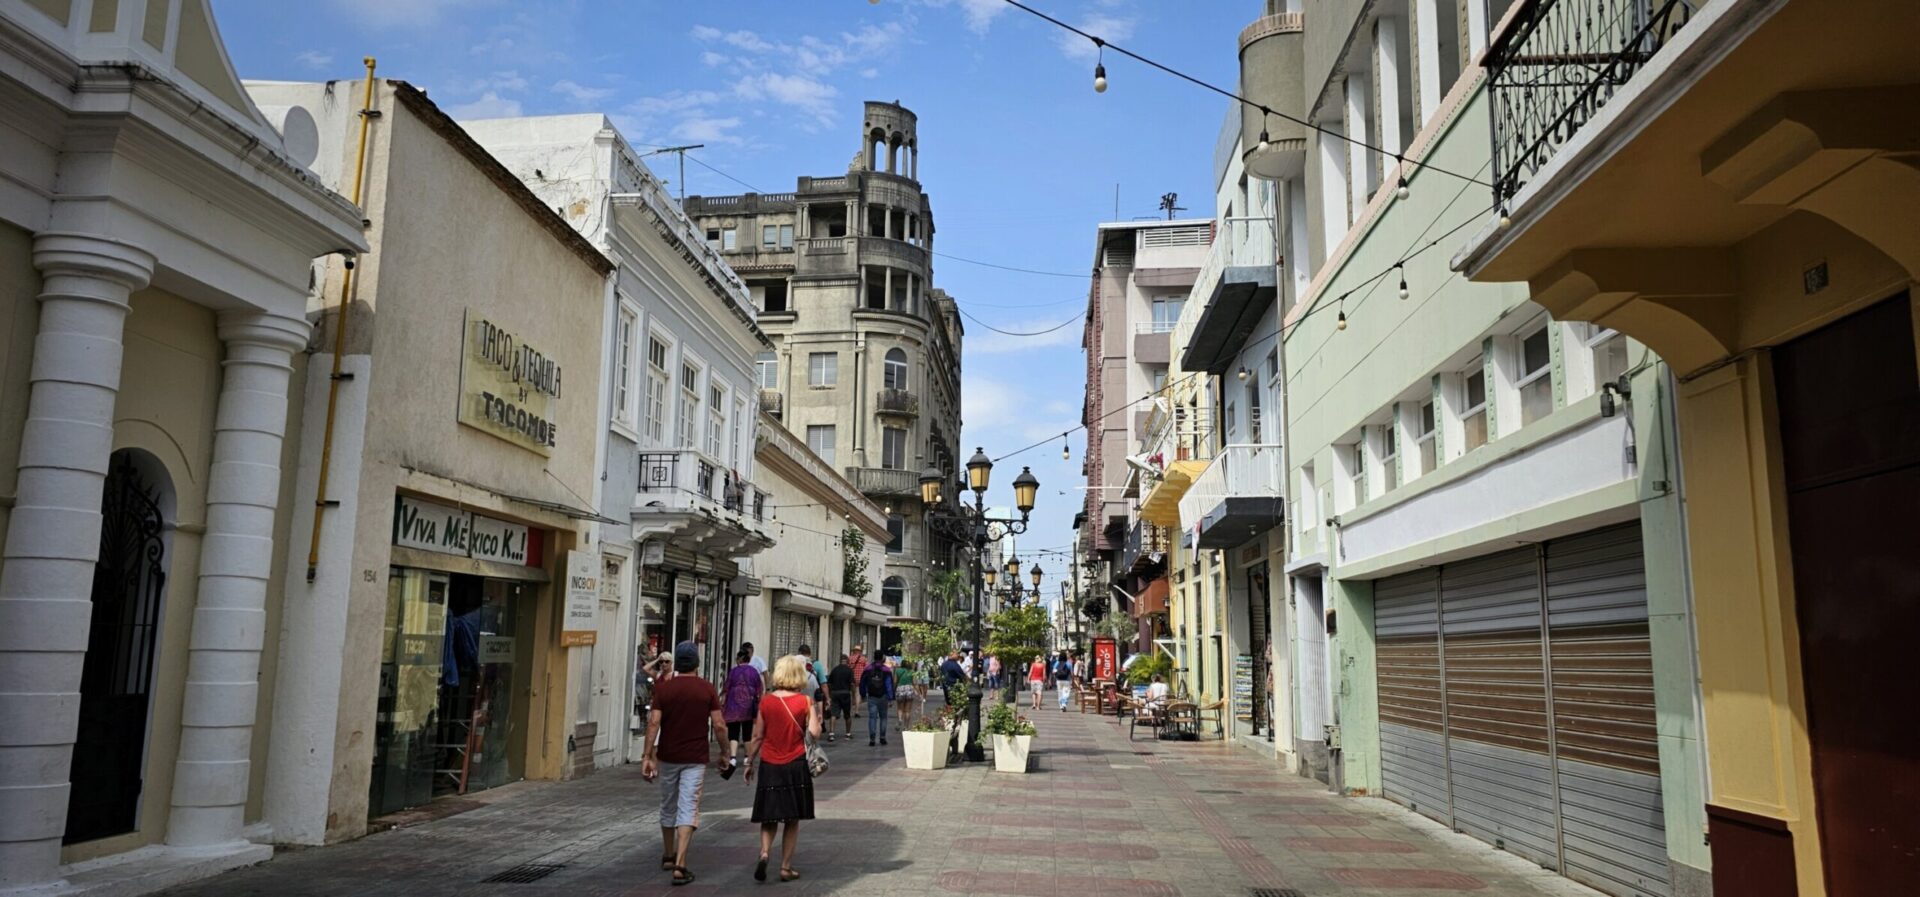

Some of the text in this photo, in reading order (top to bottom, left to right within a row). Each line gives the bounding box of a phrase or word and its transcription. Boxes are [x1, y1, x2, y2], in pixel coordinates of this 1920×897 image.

[482, 320, 561, 399] TACO & TEQUILA
[519, 387, 528, 404] BY
[363, 569, 377, 583] 154
